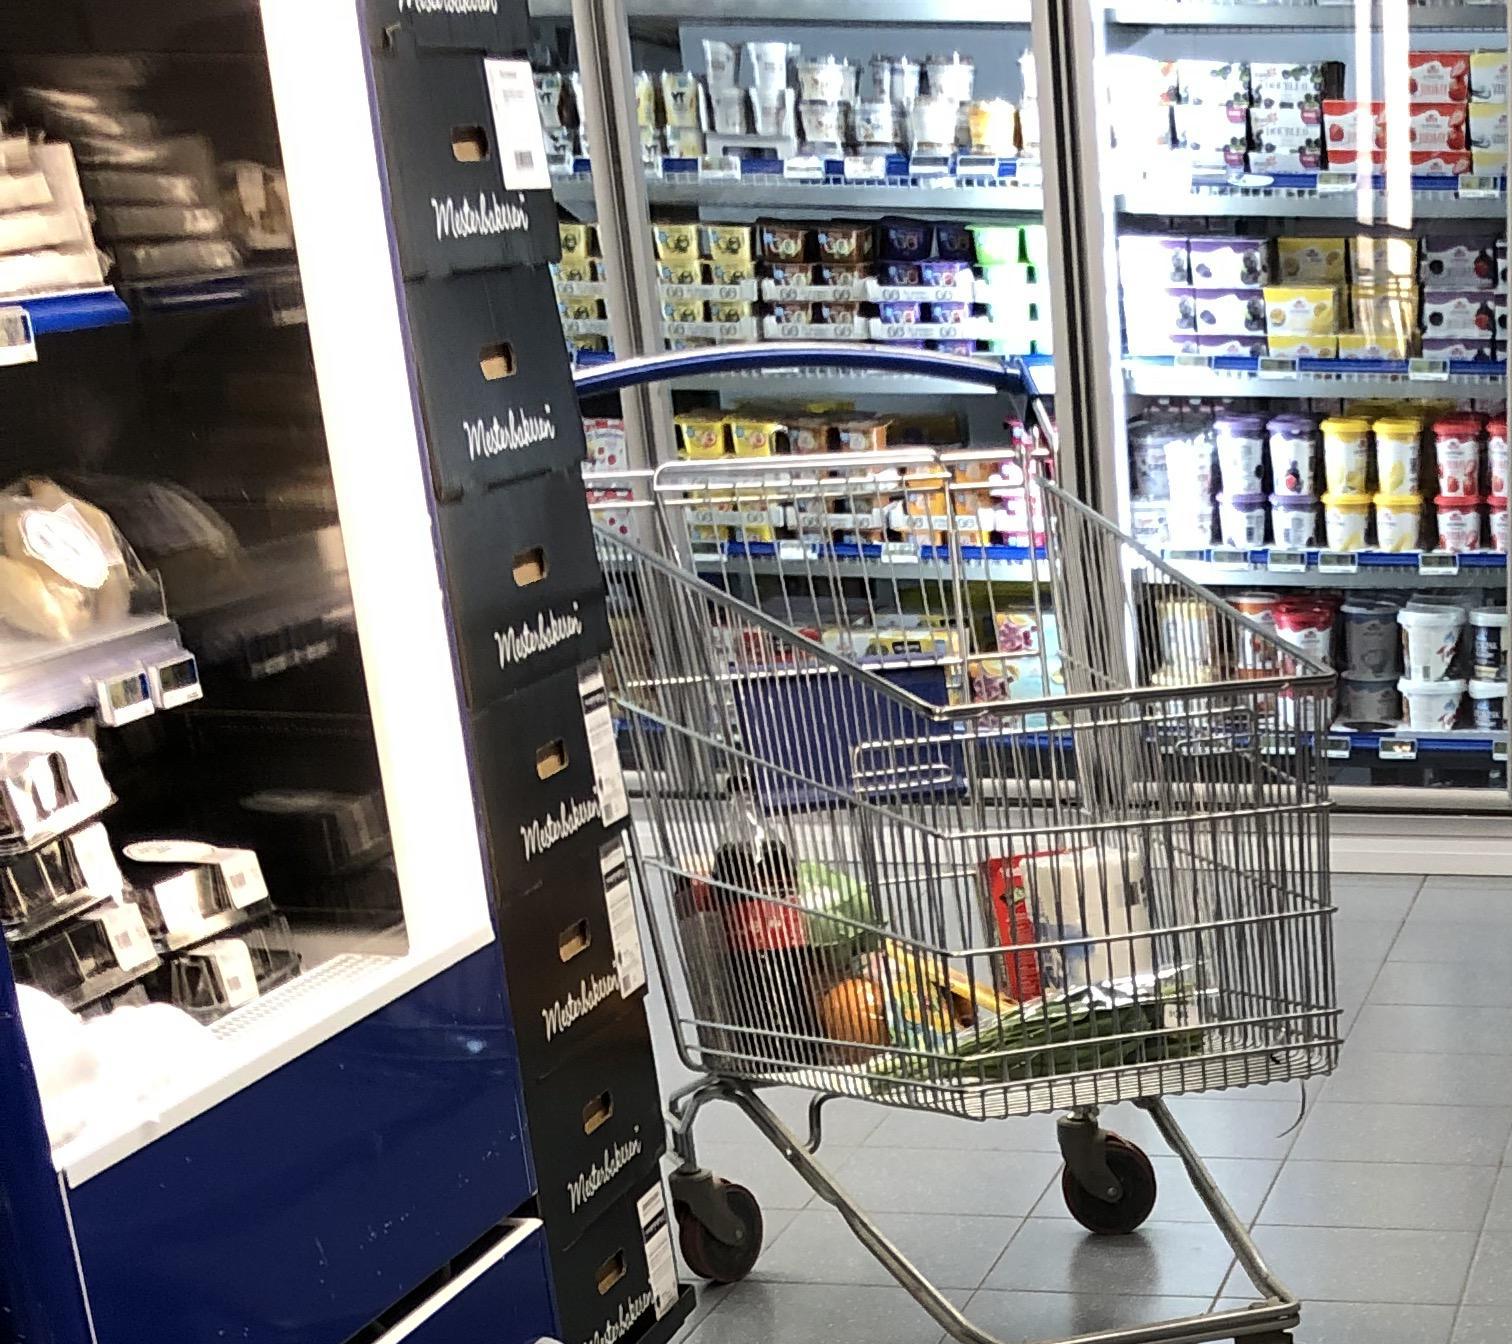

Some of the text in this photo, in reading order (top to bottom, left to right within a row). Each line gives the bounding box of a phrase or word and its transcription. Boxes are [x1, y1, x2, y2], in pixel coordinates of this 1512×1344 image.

[431, 192, 529, 241] Mesterbakeren
[463, 407, 555, 461] Mesterbakeren
[494, 608, 582, 670] Mesterbakeren
[521, 796, 601, 862] Mesterbakeren
[542, 973, 621, 1043] Mesterbakeren
[568, 1138, 642, 1214] Mesterbakeren
